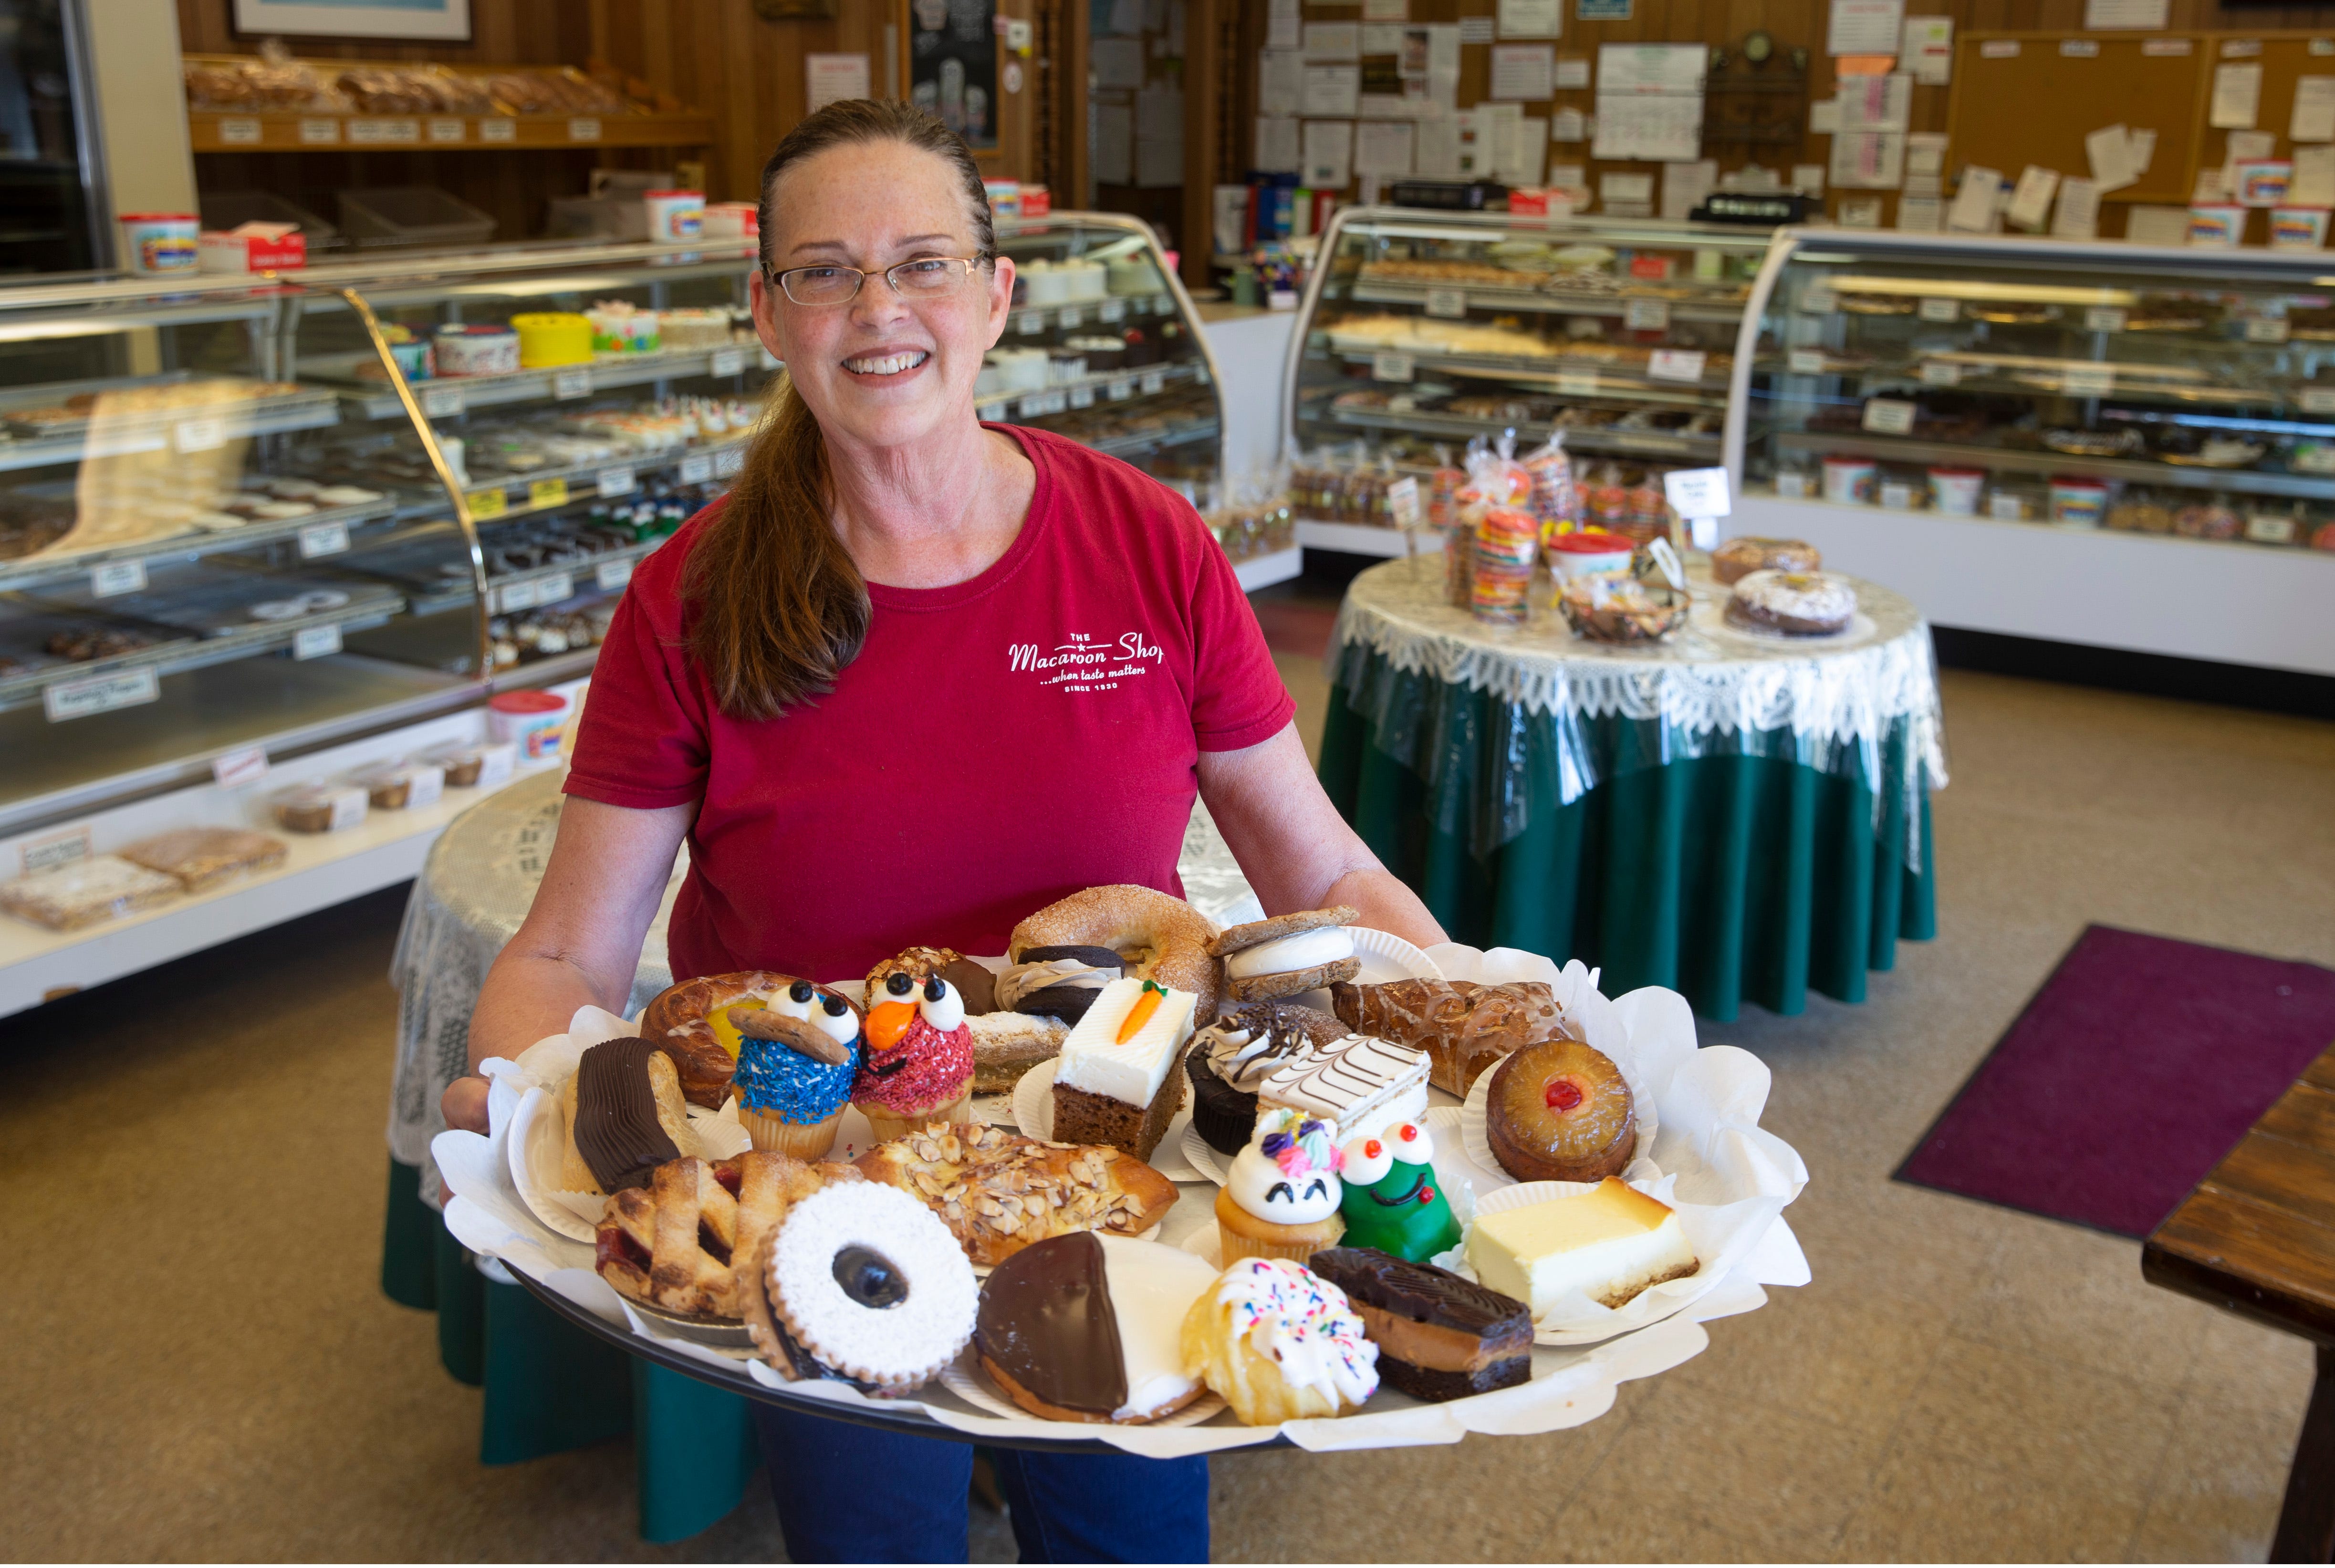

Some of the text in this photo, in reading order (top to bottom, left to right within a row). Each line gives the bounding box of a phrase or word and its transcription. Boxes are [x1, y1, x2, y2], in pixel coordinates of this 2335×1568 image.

[1070, 633, 1091, 642] THE
[1008, 644, 1107, 672] Macaroon
[1080, 668, 1105, 680] taste
[1108, 664, 1146, 678] matters
